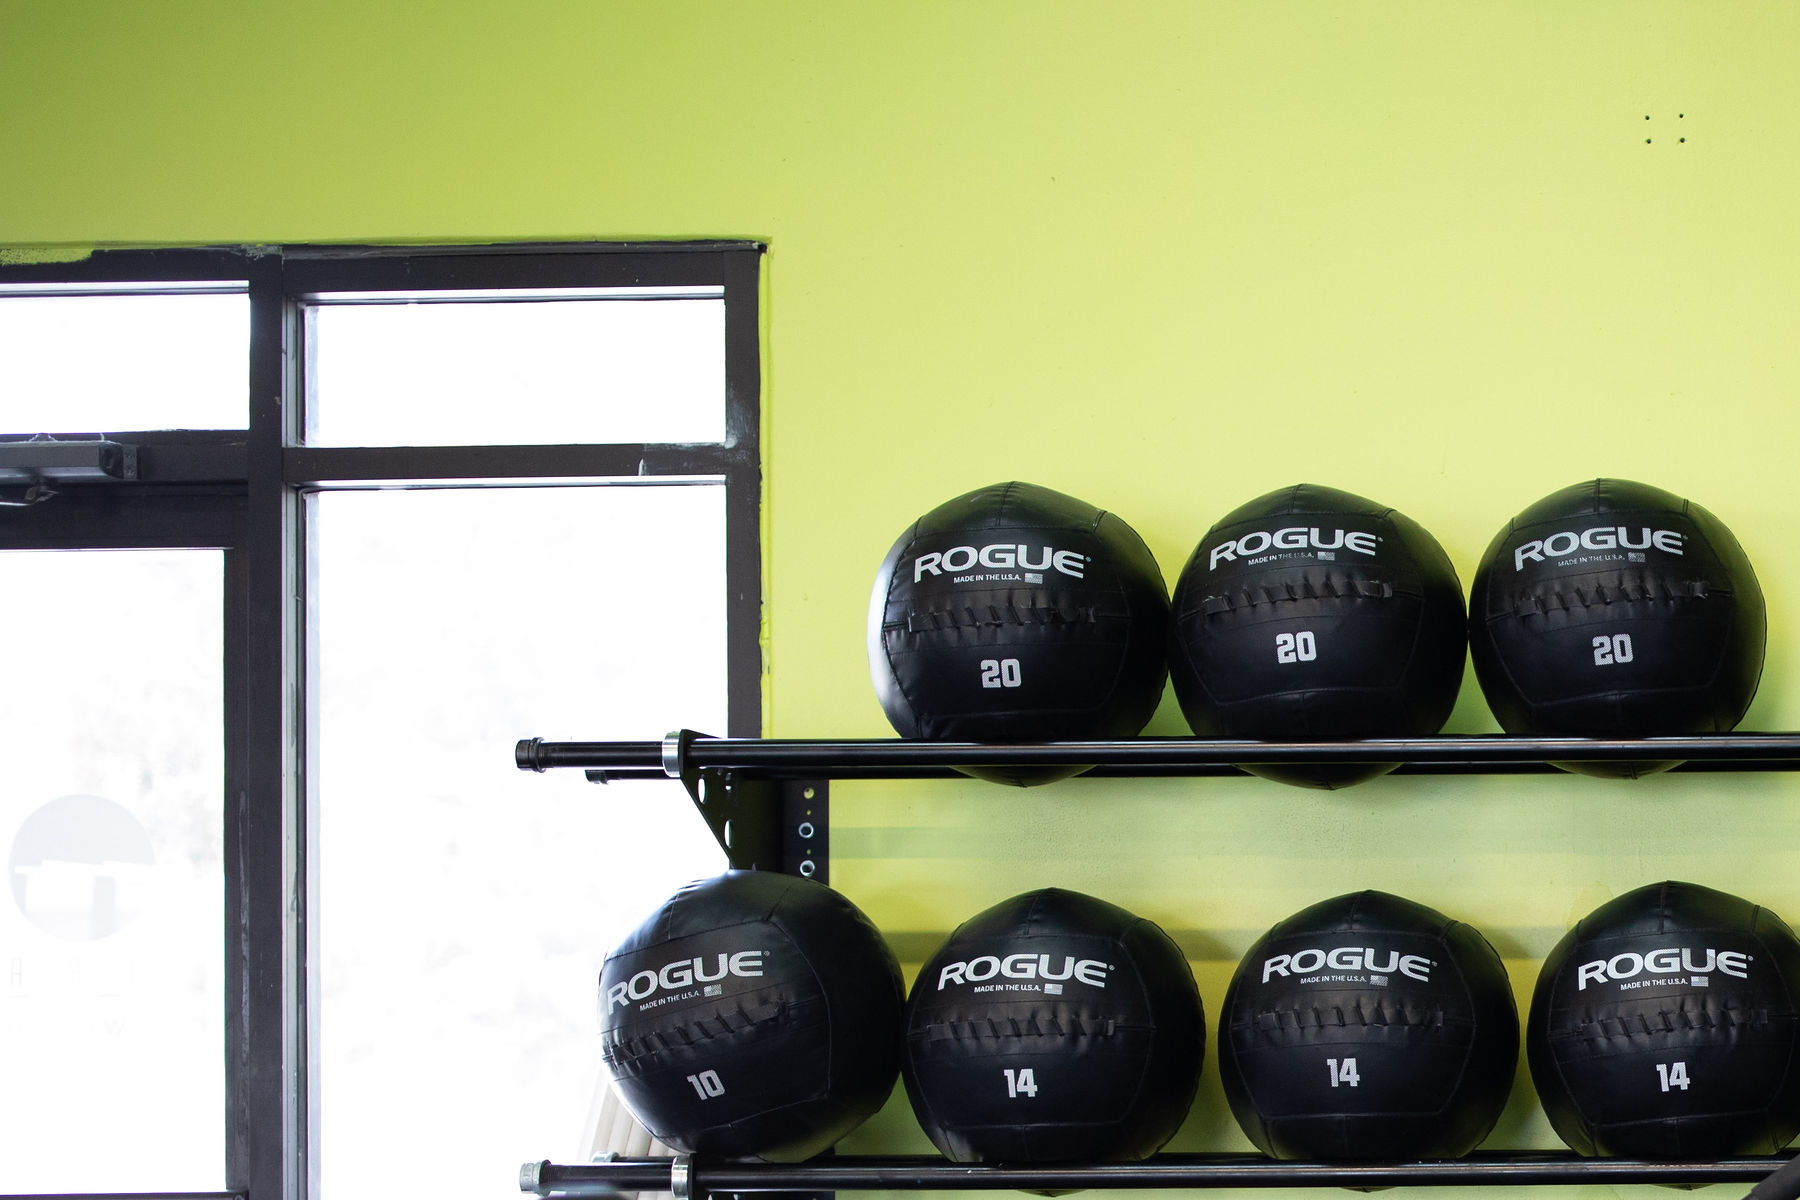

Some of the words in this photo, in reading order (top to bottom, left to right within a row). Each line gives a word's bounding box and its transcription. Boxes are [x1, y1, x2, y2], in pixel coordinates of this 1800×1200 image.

[914, 544, 1085, 583] ROGUE
[1209, 527, 1376, 571] ROGUE
[1248, 556, 1269, 566] MADE
[1269, 554, 1277, 562] IN
[1514, 526, 1684, 572] ROGUE
[1558, 558, 1578, 567] MADE
[954, 575, 975, 584] MADE
[975, 574, 984, 582] IN
[1276, 631, 1317, 664] 20
[1592, 634, 1633, 665] 20
[981, 659, 1021, 688] 20
[937, 953, 1108, 991] ROGUE
[1262, 947, 1431, 984] ROGUE
[1578, 947, 1748, 991] ROGUE
[607, 950, 763, 1015] ROGUE
[974, 984, 995, 993] MADE
[1300, 977, 1321, 985] MADE
[1620, 982, 1641, 991] MADE
[639, 999, 658, 1012] MADE
[658, 997, 666, 1006] IN
[667, 994, 680, 1004] THE
[687, 1070, 725, 1100] 10
[1004, 1069, 1037, 1098] 14
[1327, 1058, 1360, 1087] 14
[1656, 1062, 1690, 1092] 14
